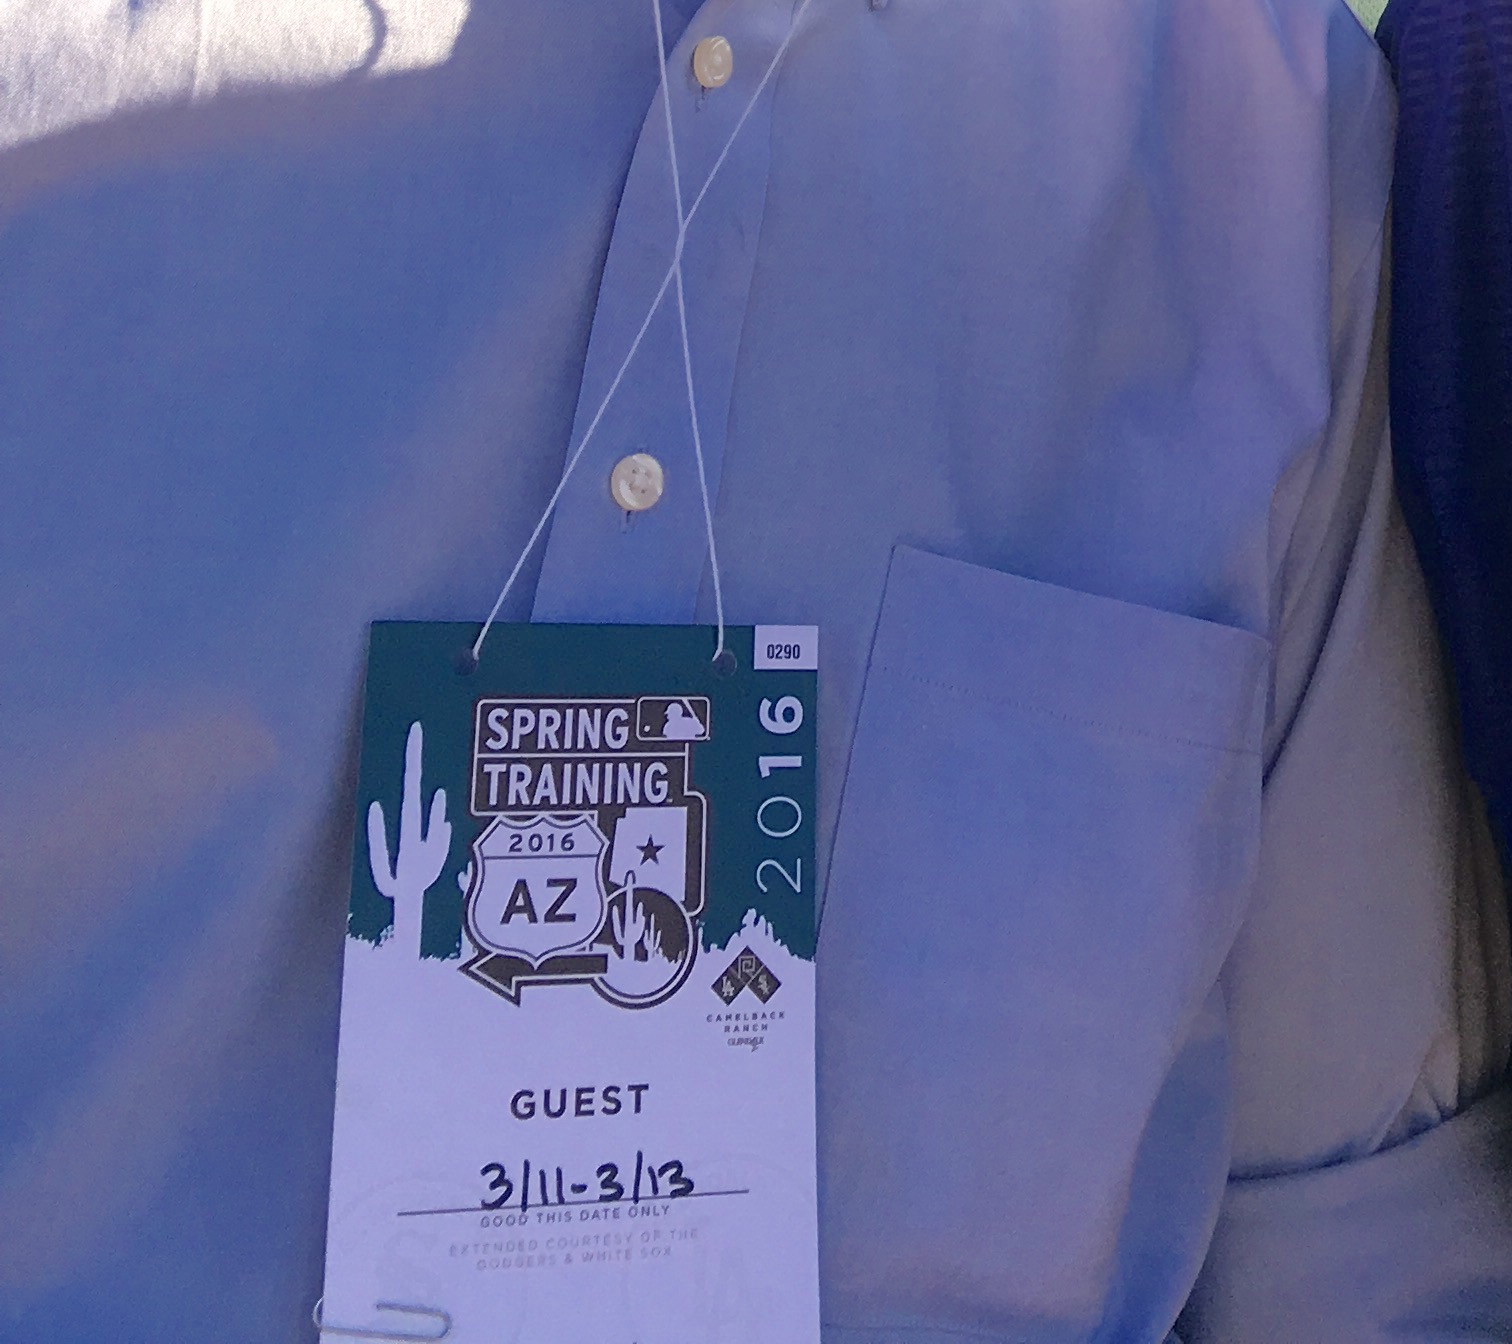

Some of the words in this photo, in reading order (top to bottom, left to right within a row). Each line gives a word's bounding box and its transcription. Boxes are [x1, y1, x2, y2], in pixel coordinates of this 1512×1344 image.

[766, 643, 801, 660] 0290
[484, 707, 630, 750] SPRING
[483, 762, 669, 807] TRAINING
[756, 695, 804, 894] 2016
[508, 831, 575, 853] 2016
[499, 877, 578, 925] AZ
[706, 1011, 785, 1023] CAMELBACK
[724, 1023, 768, 1033] RANCH
[510, 1083, 650, 1120] GUEST
[479, 1149, 696, 1213] 3/11-3/13
[480, 1213, 528, 1229] GOOD
[537, 1210, 573, 1224] THIS
[579, 1205, 620, 1222] DATE
[627, 1203, 671, 1218] ONLY
[449, 1239, 538, 1258] EXTENDED
[545, 1231, 633, 1249] COURTESY
[670, 1226, 699, 1241] THE
[581, 1247, 632, 1263] WHITE
